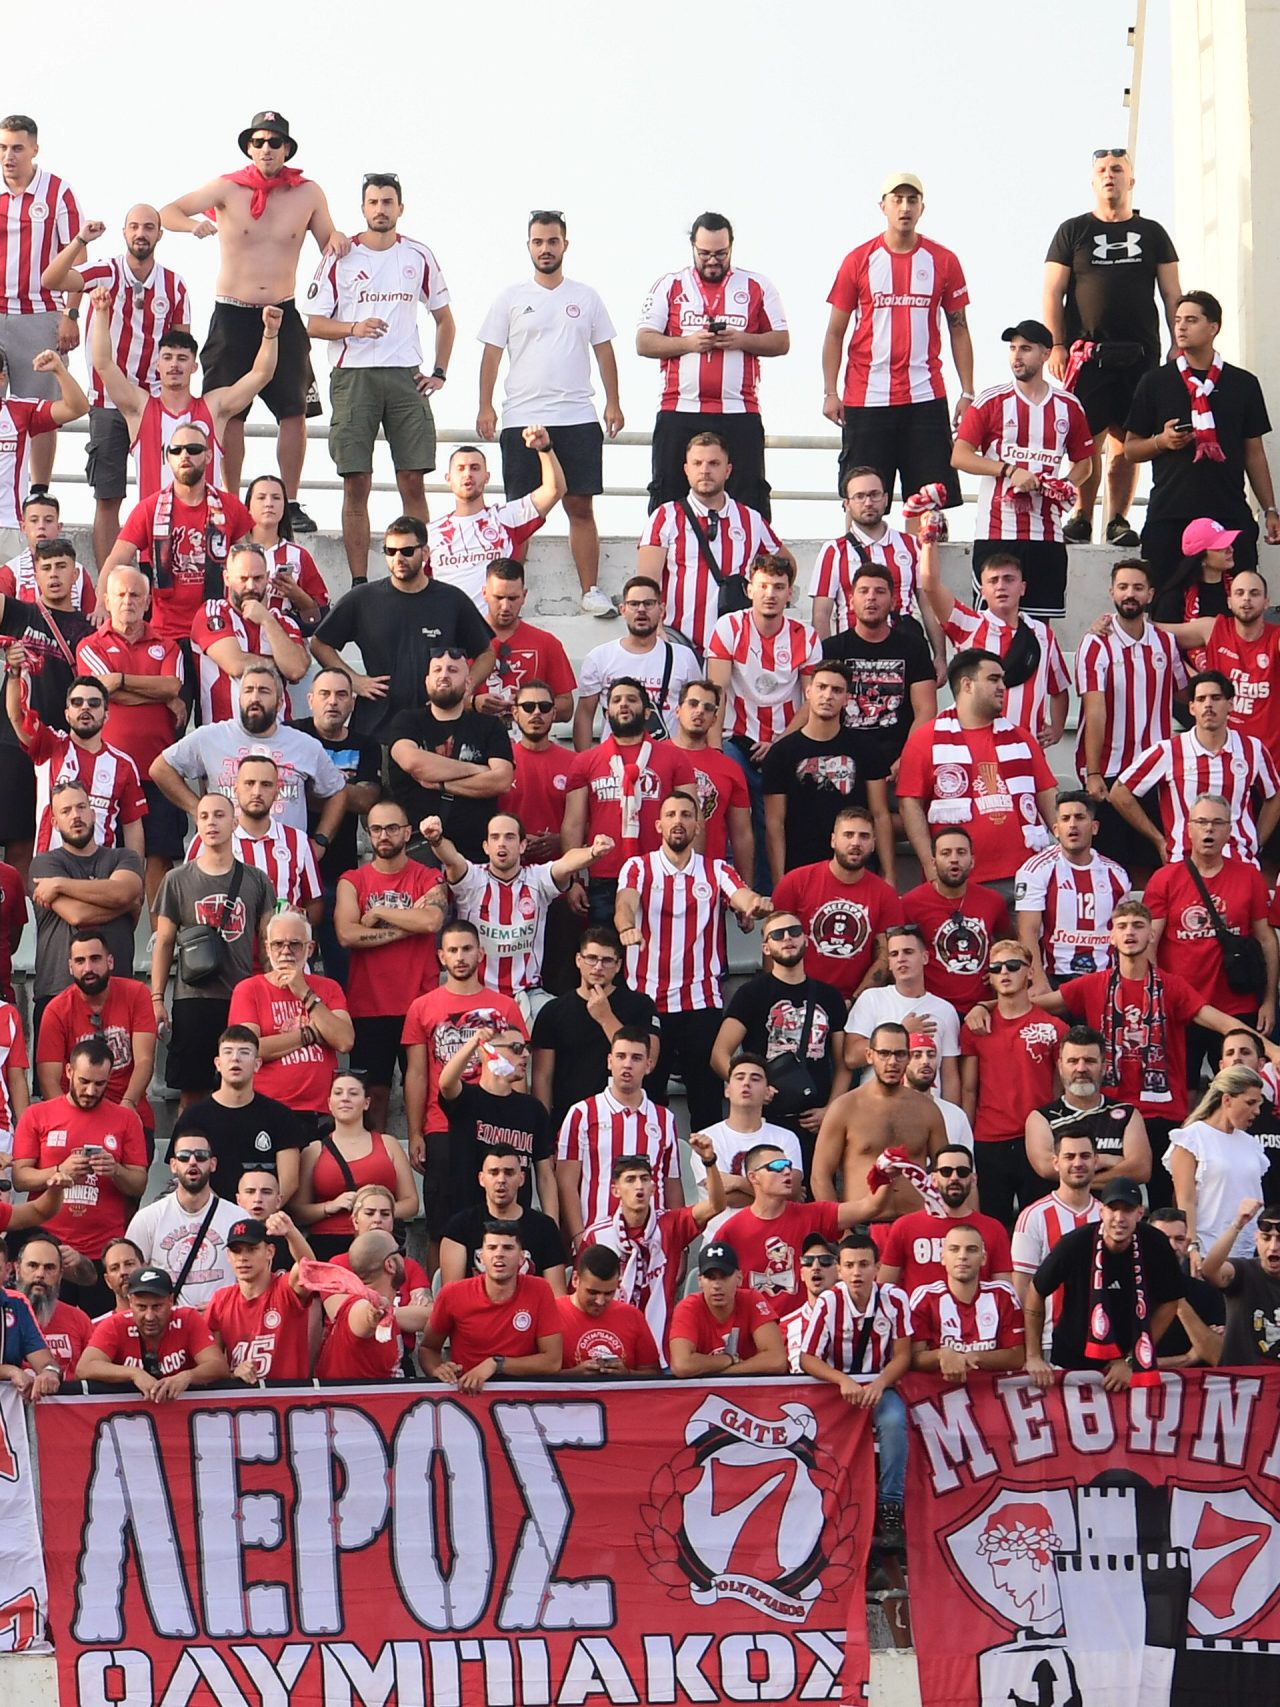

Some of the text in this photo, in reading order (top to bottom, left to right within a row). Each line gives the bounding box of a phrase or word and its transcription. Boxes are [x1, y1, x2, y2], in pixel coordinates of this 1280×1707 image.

[872, 291, 931, 308] Stoiximan
[681, 310, 746, 328] Stoiiman
[1003, 446, 1063, 464] Stoixima
[438, 551, 501, 567] Stoiximan
[823, 900, 862, 920] ΜΕΓΑΡΑ
[1077, 891, 1096, 920] 12
[479, 923, 534, 941] SIEMENS
[942, 919, 981, 934] ΜΕΑΡΑ
[942, 1336, 997, 1353] Stoixima
[720, 1407, 788, 1446] GATE
[910, 1370, 1280, 1497] ΜΕΘΩΝ
[70, 1396, 616, 1644] ΛΕΡΟΣ
[711, 1457, 799, 1580] 7
[1190, 1501, 1273, 1620] 7
[718, 1579, 806, 1618] OLYMPIAKOS
[76, 1631, 850, 1707] ΟΛΥΜΠΙΑΚΟΣ
